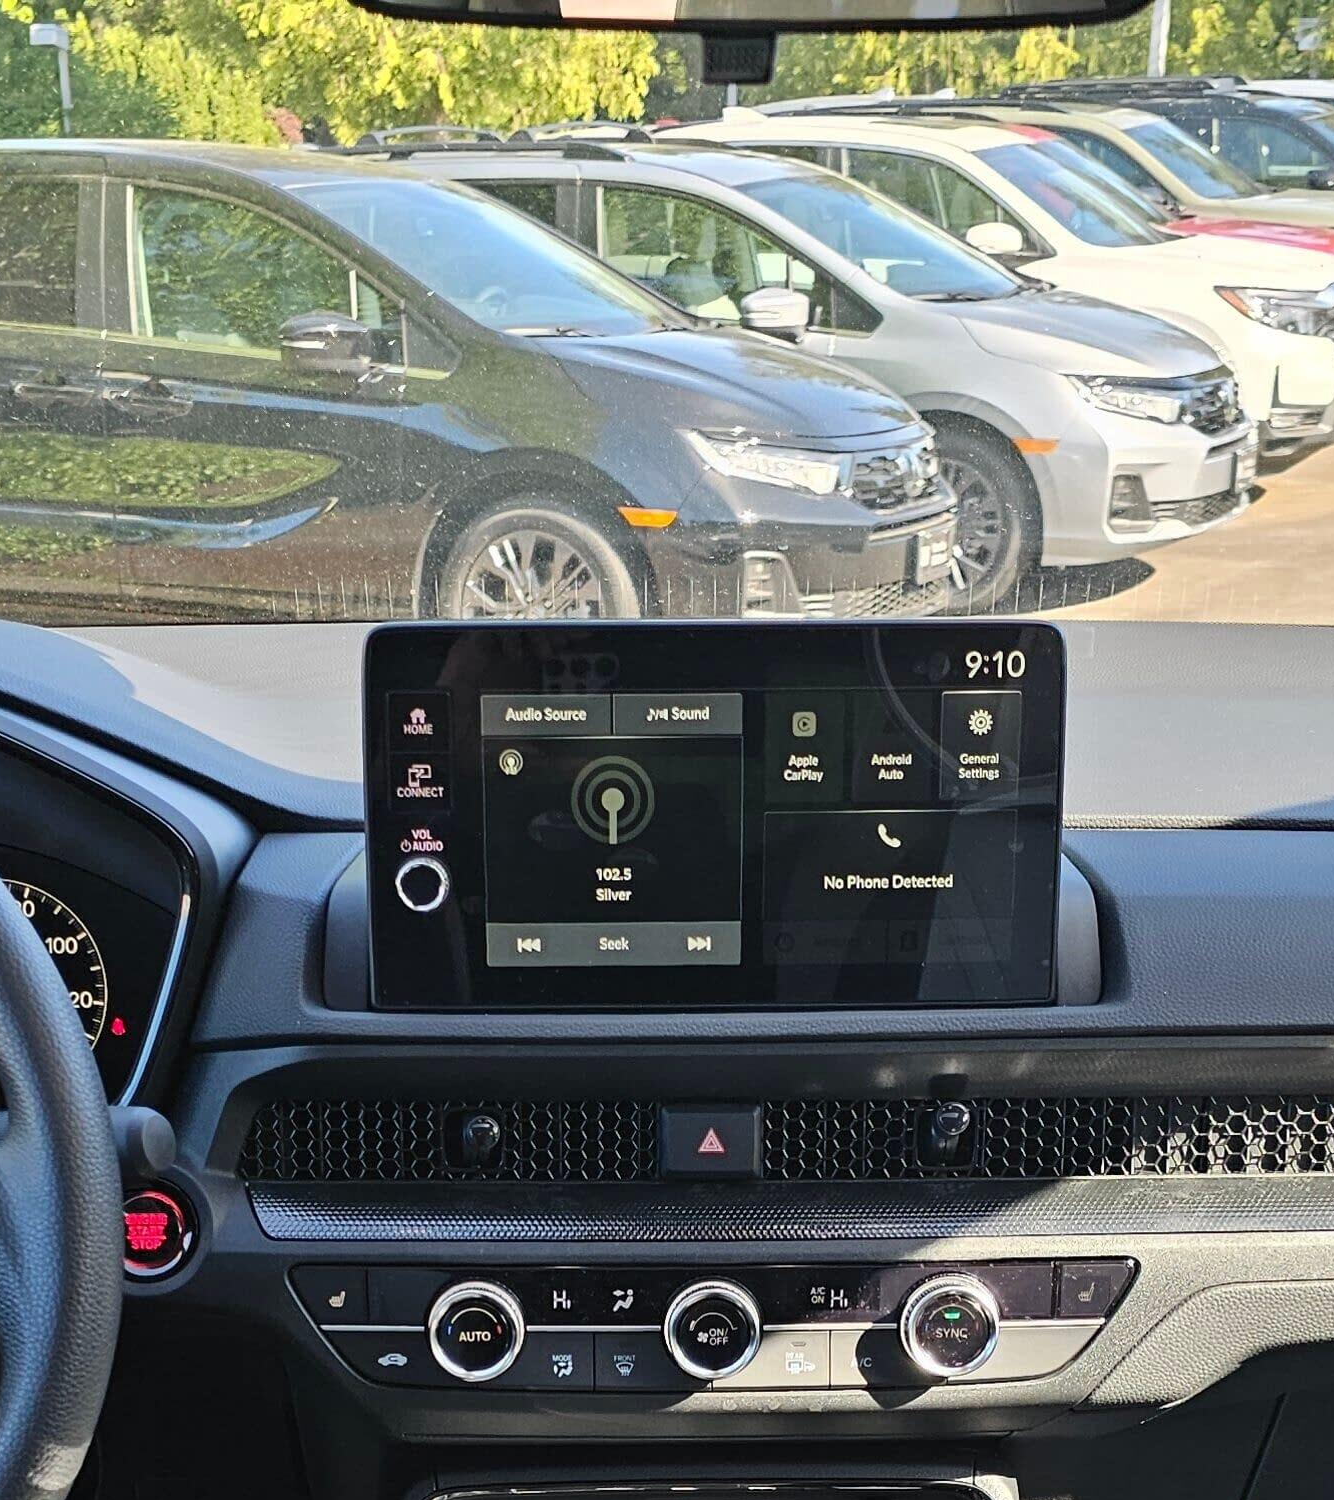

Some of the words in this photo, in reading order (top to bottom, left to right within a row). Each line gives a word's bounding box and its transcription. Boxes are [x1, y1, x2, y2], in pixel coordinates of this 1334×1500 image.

[965, 650, 1026, 679] 9:10
[505, 707, 543, 722] Audio
[544, 707, 587, 722] Source
[671, 706, 711, 722] Sound
[403, 723, 434, 736] HOME
[788, 754, 819, 769] Apple
[871, 753, 912, 766] Android
[959, 752, 999, 765] General
[783, 769, 824, 783] CarPlay
[878, 768, 904, 780] Auto
[958, 767, 1000, 781] Settings
[397, 786, 444, 799] CONNECT
[411, 829, 433, 841] VOL
[412, 841, 444, 853] AUDIO
[595, 867, 633, 882] 102.5
[823, 875, 844, 891] No
[847, 874, 890, 891] Phone
[892, 873, 954, 890] Detected
[595, 887, 633, 902] Silver
[44, 936, 79, 955] 100
[599, 936, 631, 951] Seek
[69, 990, 94, 1009] 20
[125, 1212, 168, 1225] ENGINE
[128, 1225, 165, 1236] START
[131, 1239, 162, 1250] STOP
[810, 1287, 826, 1295] A/C
[811, 1295, 825, 1304] ON
[458, 1331, 492, 1342] AUTO
[935, 1327, 969, 1340] SYNC
[709, 1335, 729, 1346] OFF
[850, 1358, 873, 1367] A/C
